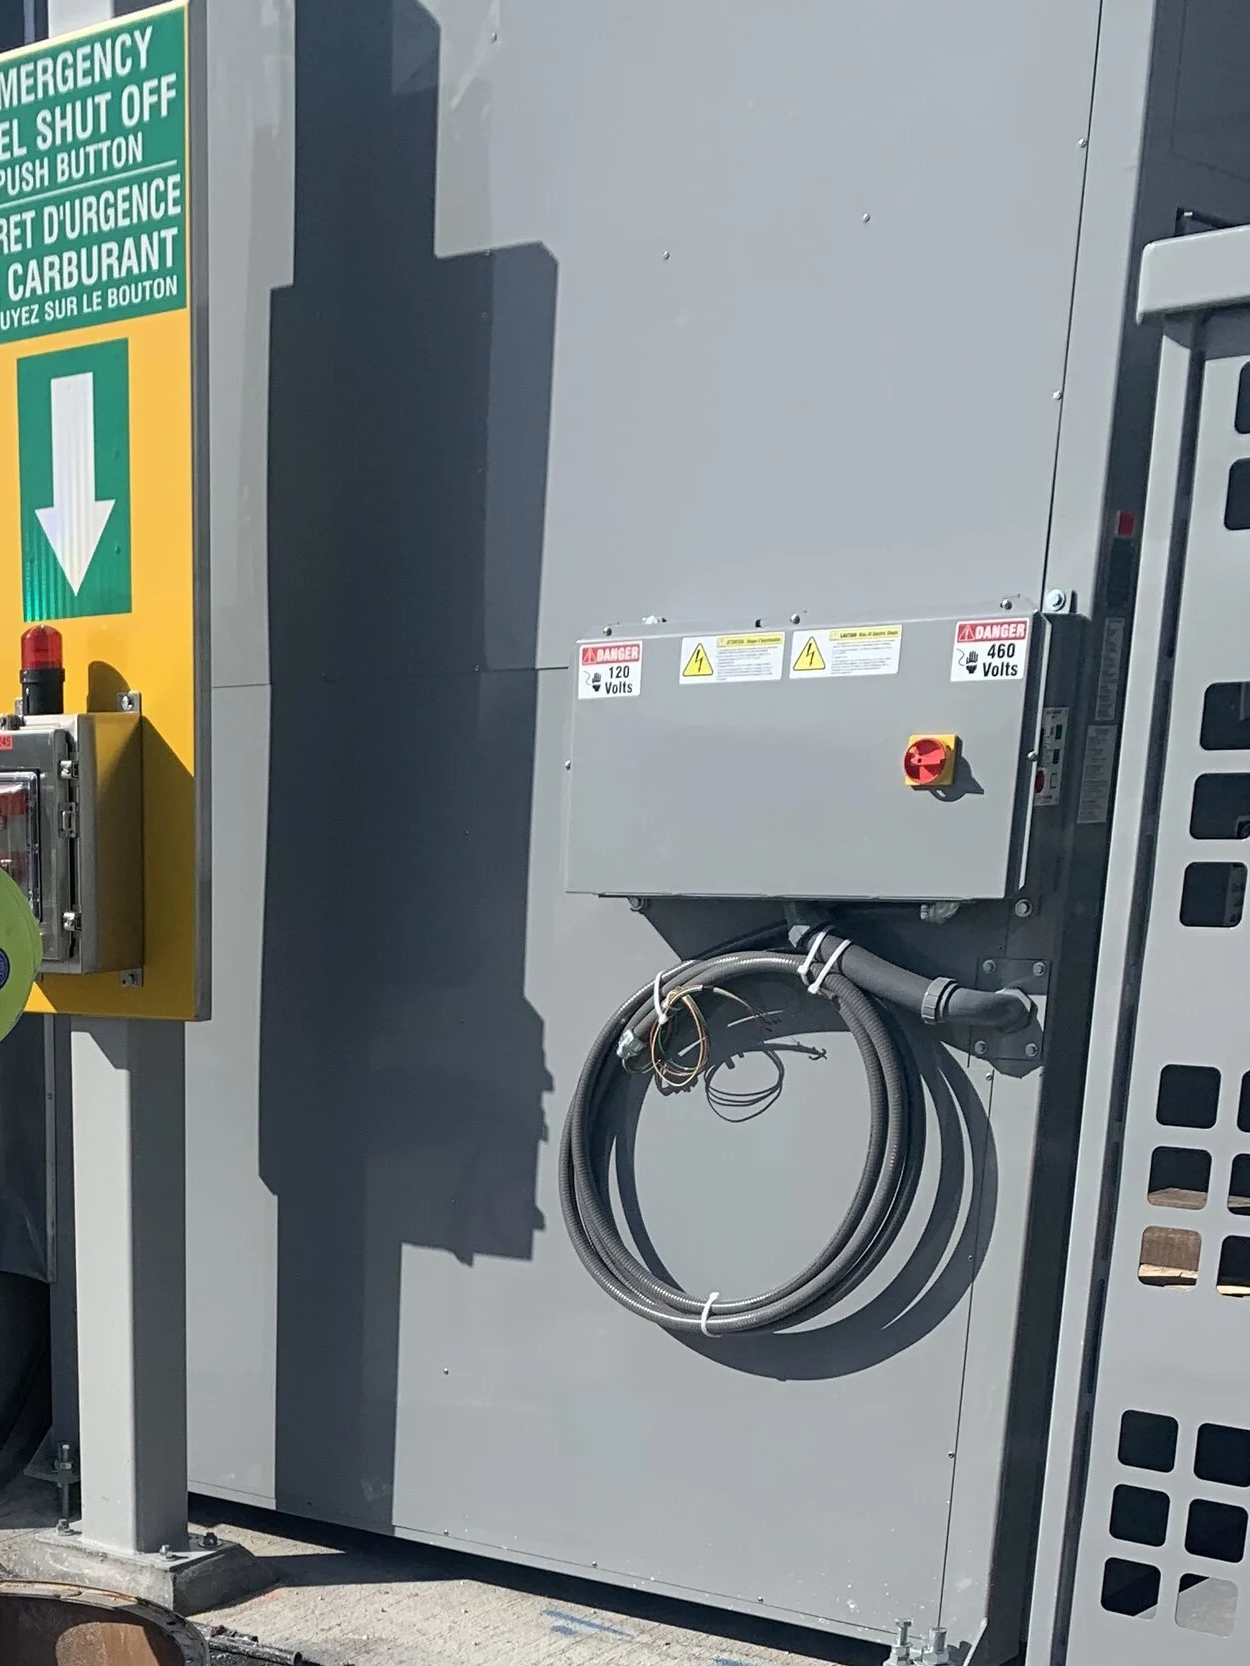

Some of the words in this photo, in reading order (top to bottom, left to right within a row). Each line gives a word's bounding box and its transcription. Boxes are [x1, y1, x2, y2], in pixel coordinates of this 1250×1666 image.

[36, 92, 112, 151] SHUT
[121, 73, 177, 127] OFF
[56, 131, 143, 183] BUTTON
[43, 173, 181, 244] D'URGENCE
[7, 227, 178, 302] CARBURANT
[44, 296, 78, 321] SUR
[83, 291, 102, 314] LE
[107, 275, 178, 308] BOUTON
[975, 623, 1026, 640] DANGER
[596, 646, 639, 662] DANGER
[987, 643, 1016, 659] 460
[608, 665, 630, 679] 120
[982, 661, 1018, 677] Volts
[605, 681, 633, 695] Volts
